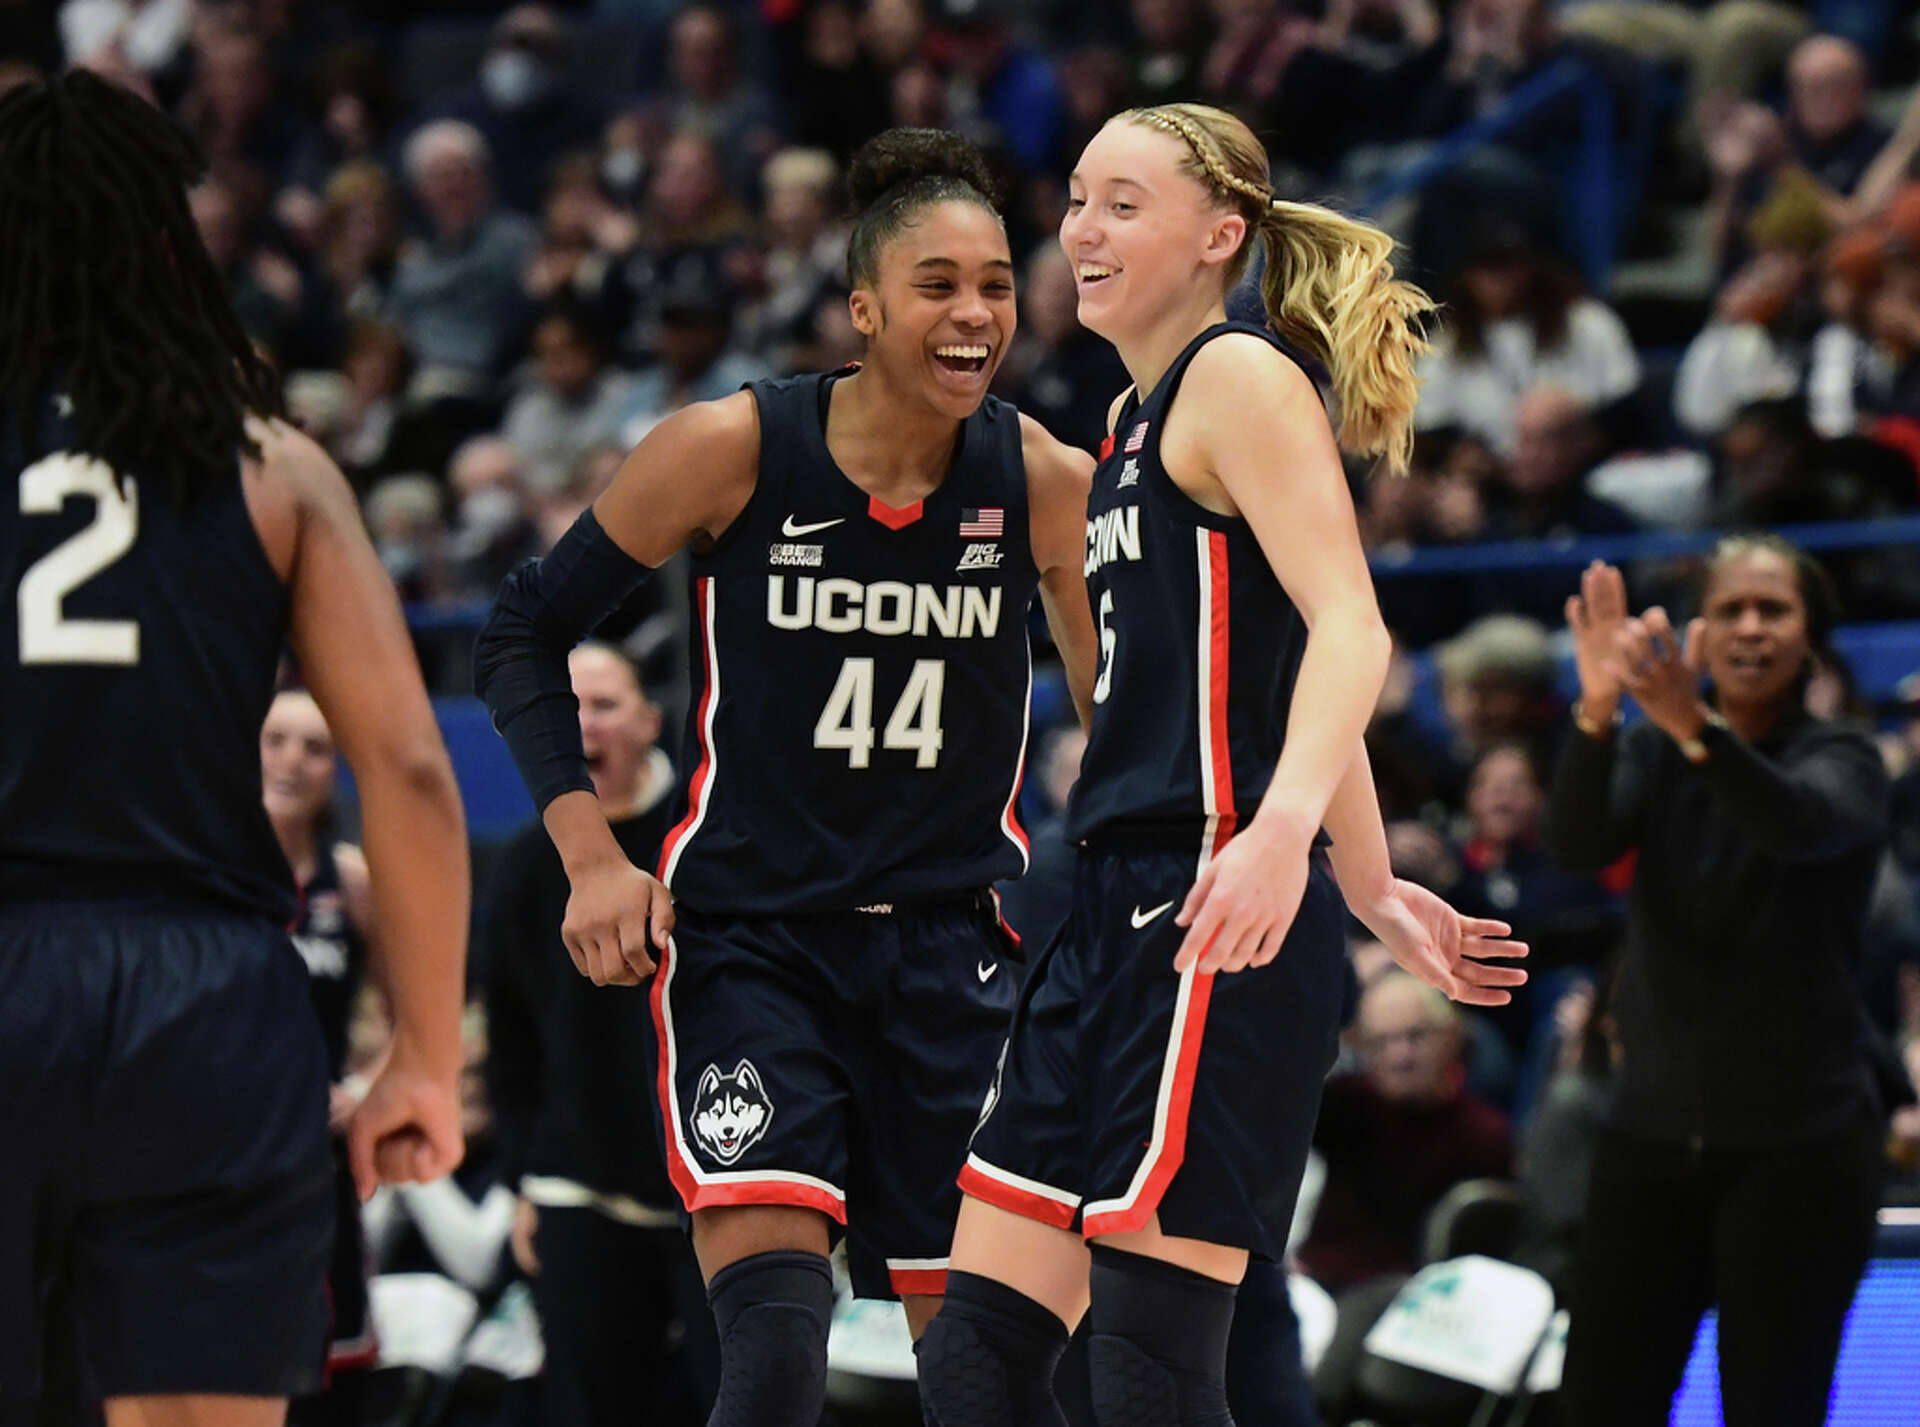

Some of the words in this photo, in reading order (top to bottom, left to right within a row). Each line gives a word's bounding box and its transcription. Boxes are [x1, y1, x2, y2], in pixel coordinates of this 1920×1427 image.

[18, 450, 139, 665] 2
[960, 553, 1004, 565] EAST
[964, 543, 998, 555] BIG
[767, 574, 1002, 638] UCONN
[813, 656, 945, 768] 44
